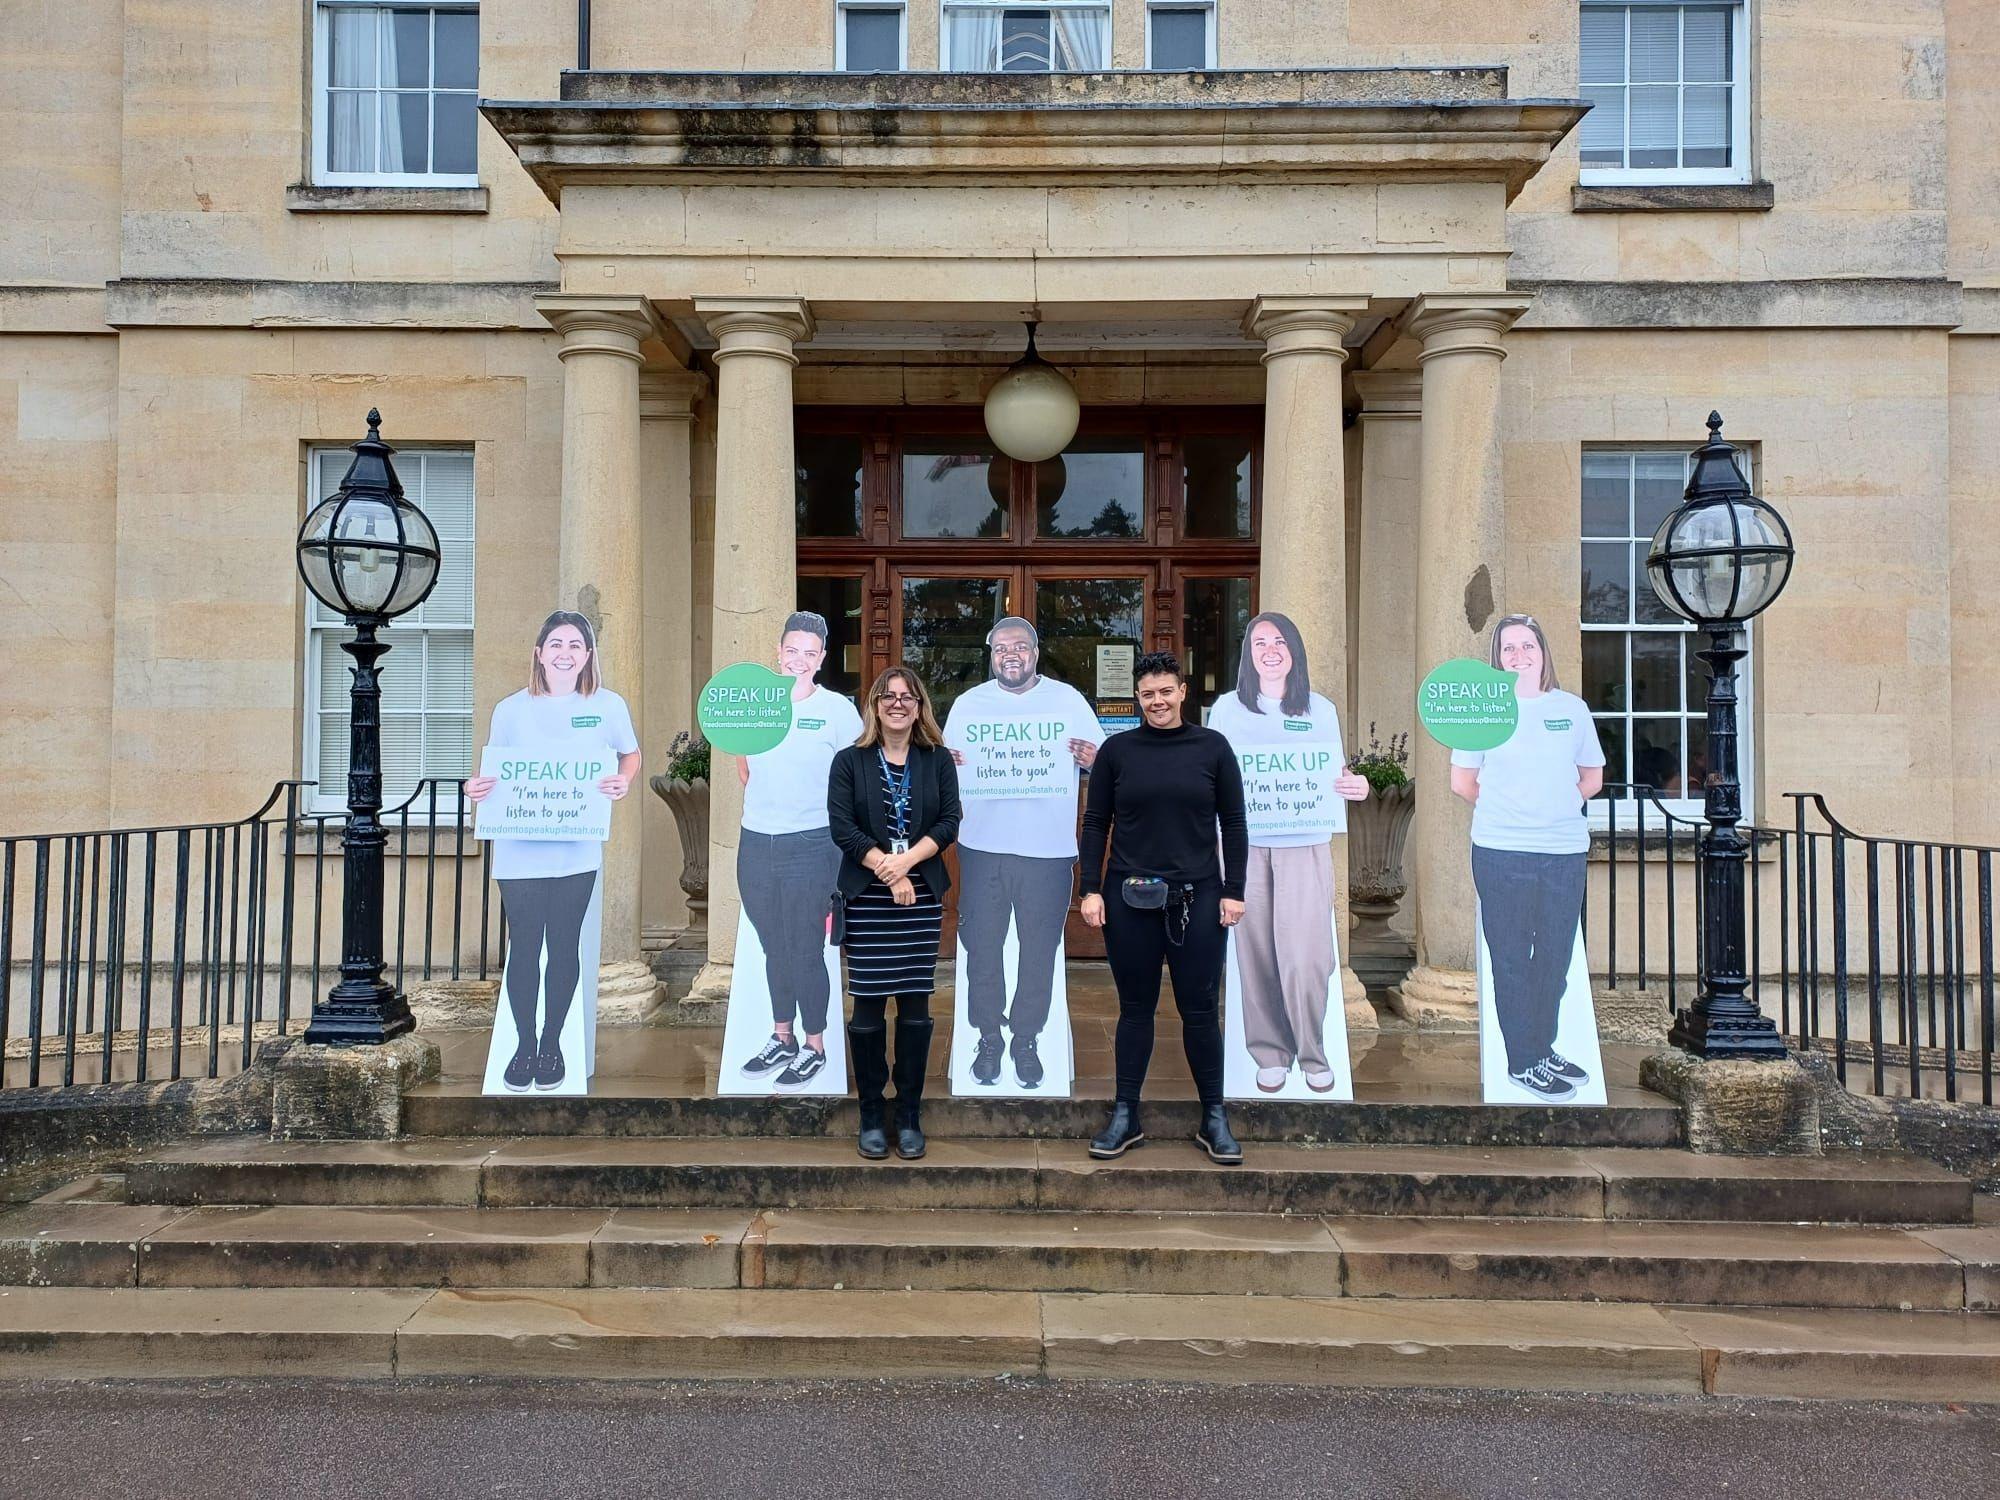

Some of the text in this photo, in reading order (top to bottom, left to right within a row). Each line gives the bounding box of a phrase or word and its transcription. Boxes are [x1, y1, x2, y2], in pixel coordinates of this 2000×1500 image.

[707, 687, 786, 703] SPEAK UP
[1428, 683, 1509, 699] SPEAK UP
[726, 706, 745, 717] here
[747, 706, 756, 717] to
[1448, 702, 1468, 713] here
[1470, 702, 1479, 713] to
[703, 720, 788, 729] freedomtospeakup@stah.org
[1425, 716, 1515, 725] freedomtospeakup@stah.org
[966, 722, 1065, 743] SPEAK UP
[1011, 746, 1035, 759] here
[1039, 745, 1051, 758] to
[1237, 751, 1330, 773] PEAK UP
[500, 761, 602, 781] SPEAK UP
[977, 763, 1006, 779] listen
[1010, 764, 1022, 777] to
[960, 785, 1068, 796] freedomtospeakup@stah.org
[1275, 778, 1301, 792] here
[1306, 778, 1318, 790] to
[543, 786, 568, 800] here
[572, 787, 584, 799] to
[506, 805, 536, 819] listen
[542, 806, 553, 818] to
[1246, 797, 1271, 813] sten
[1276, 797, 1288, 811] to
[479, 824, 605, 836] freedomtospeakup@stah.org
